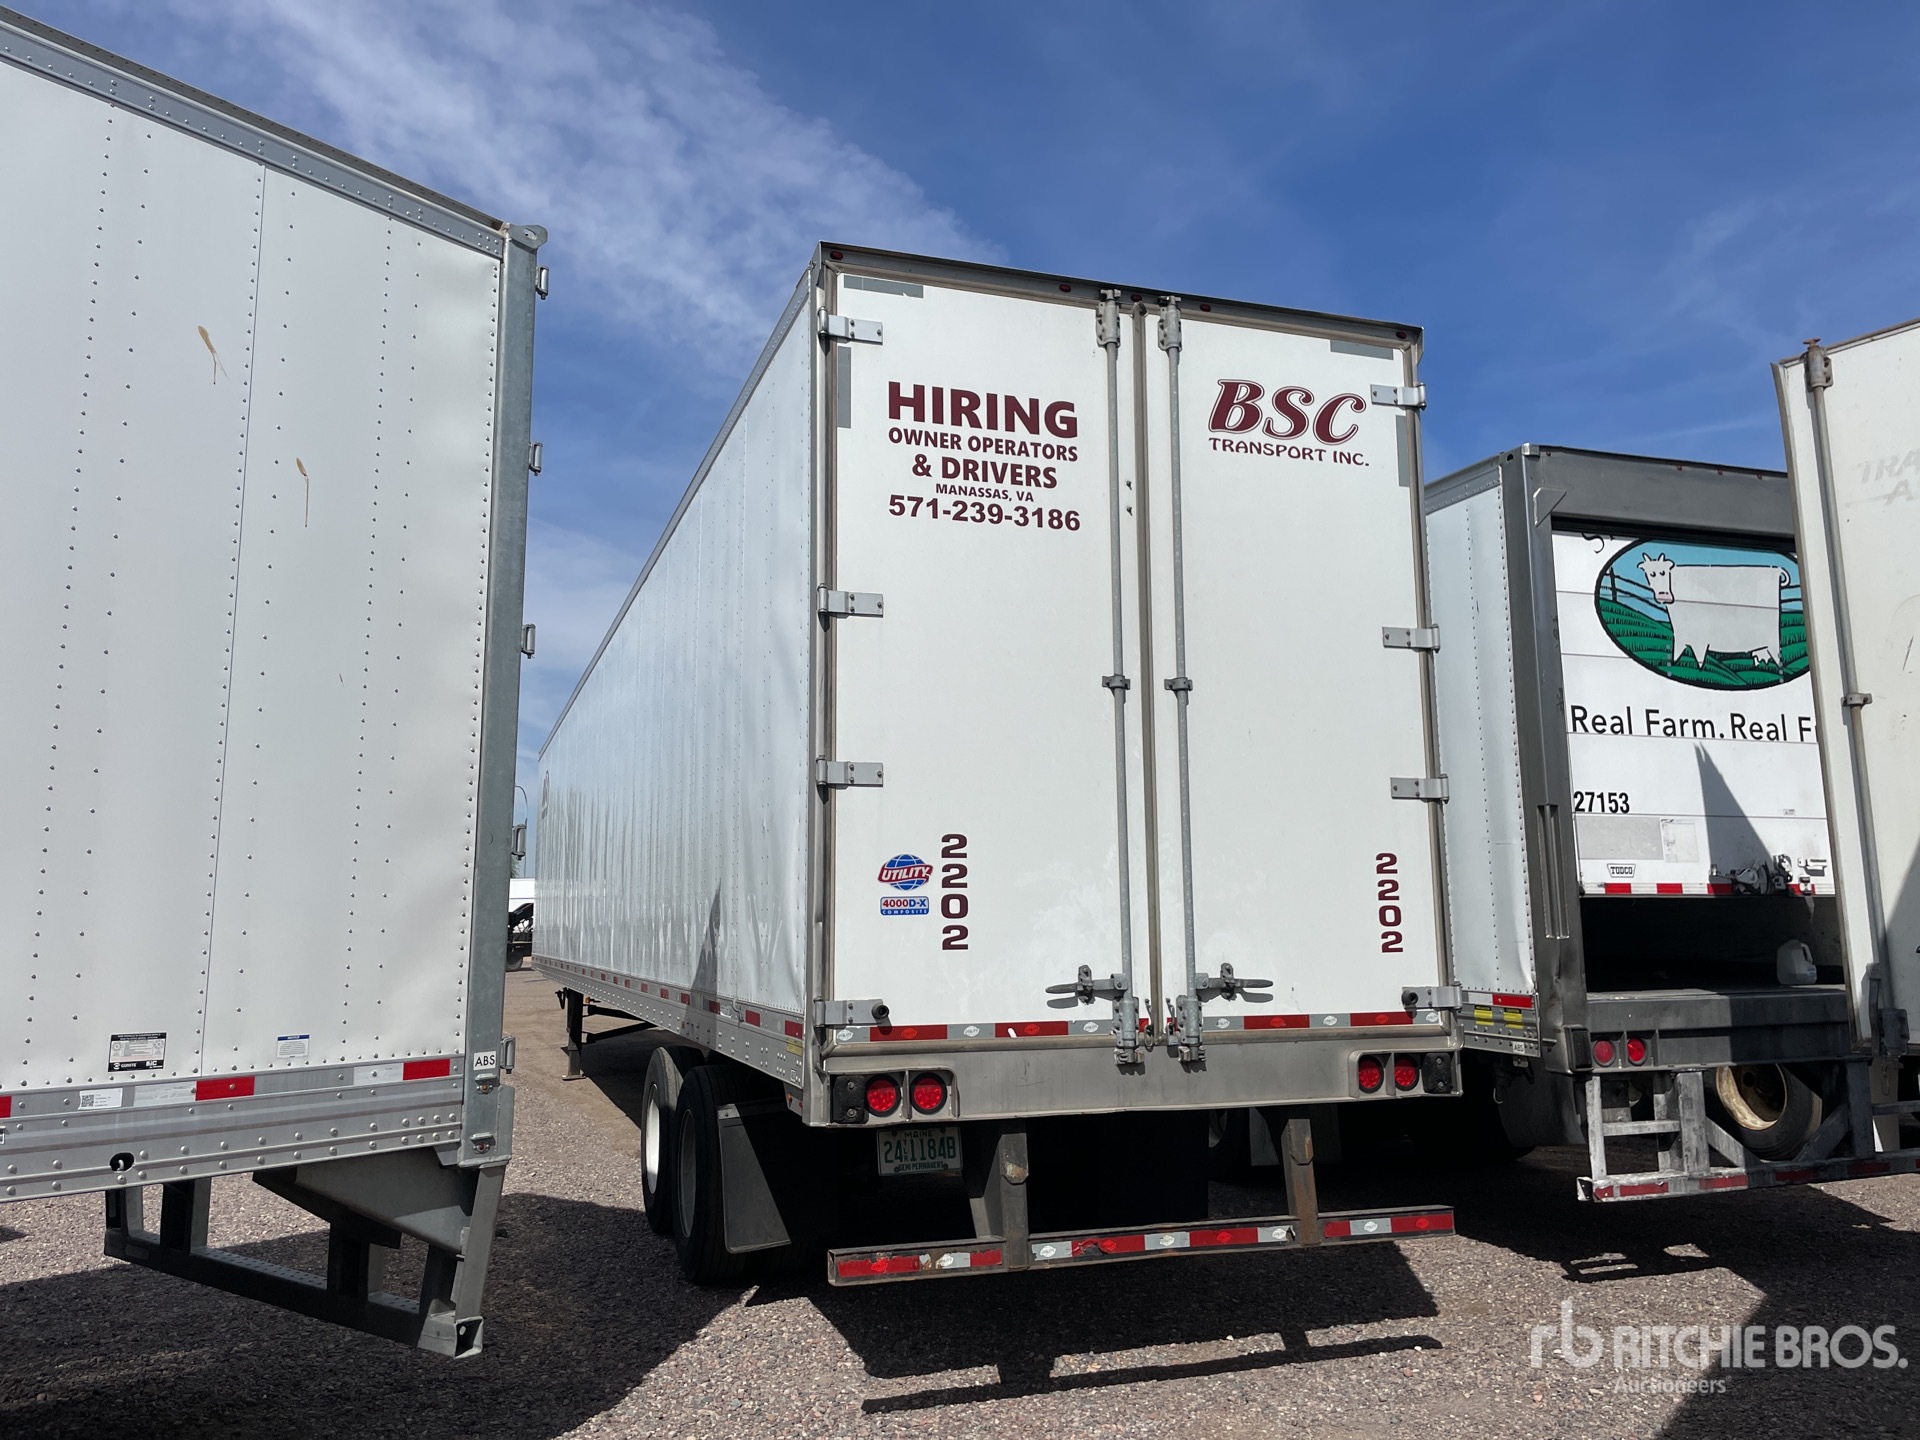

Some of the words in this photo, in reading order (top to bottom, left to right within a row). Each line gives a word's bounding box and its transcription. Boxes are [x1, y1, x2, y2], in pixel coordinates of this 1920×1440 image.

[888, 380, 1078, 439] HIRING
[1207, 378, 1367, 446] BSC
[888, 426, 962, 451] OWNER
[967, 435, 1078, 462] OPERATORS
[1208, 437, 1327, 462] TRANSPORT
[1332, 450, 1370, 467] INC.
[911, 453, 933, 478] &
[941, 456, 1058, 489] DRIVERS
[935, 483, 1011, 502] MANASSAS,
[1015, 490, 1034, 503] VA
[888, 494, 1081, 532] 571-239-3186
[1570, 704, 1633, 736] Real
[1645, 708, 1725, 739] Farm.
[1730, 712, 1787, 742] Real
[1573, 790, 1630, 814] 27153
[881, 866, 931, 881] UTILITY
[882, 898, 927, 908] 4000D-X
[940, 833, 969, 951] 2202
[1375, 852, 1404, 954] 2202
[474, 1054, 496, 1068] ABS
[904, 1130, 934, 1139] MAINE
